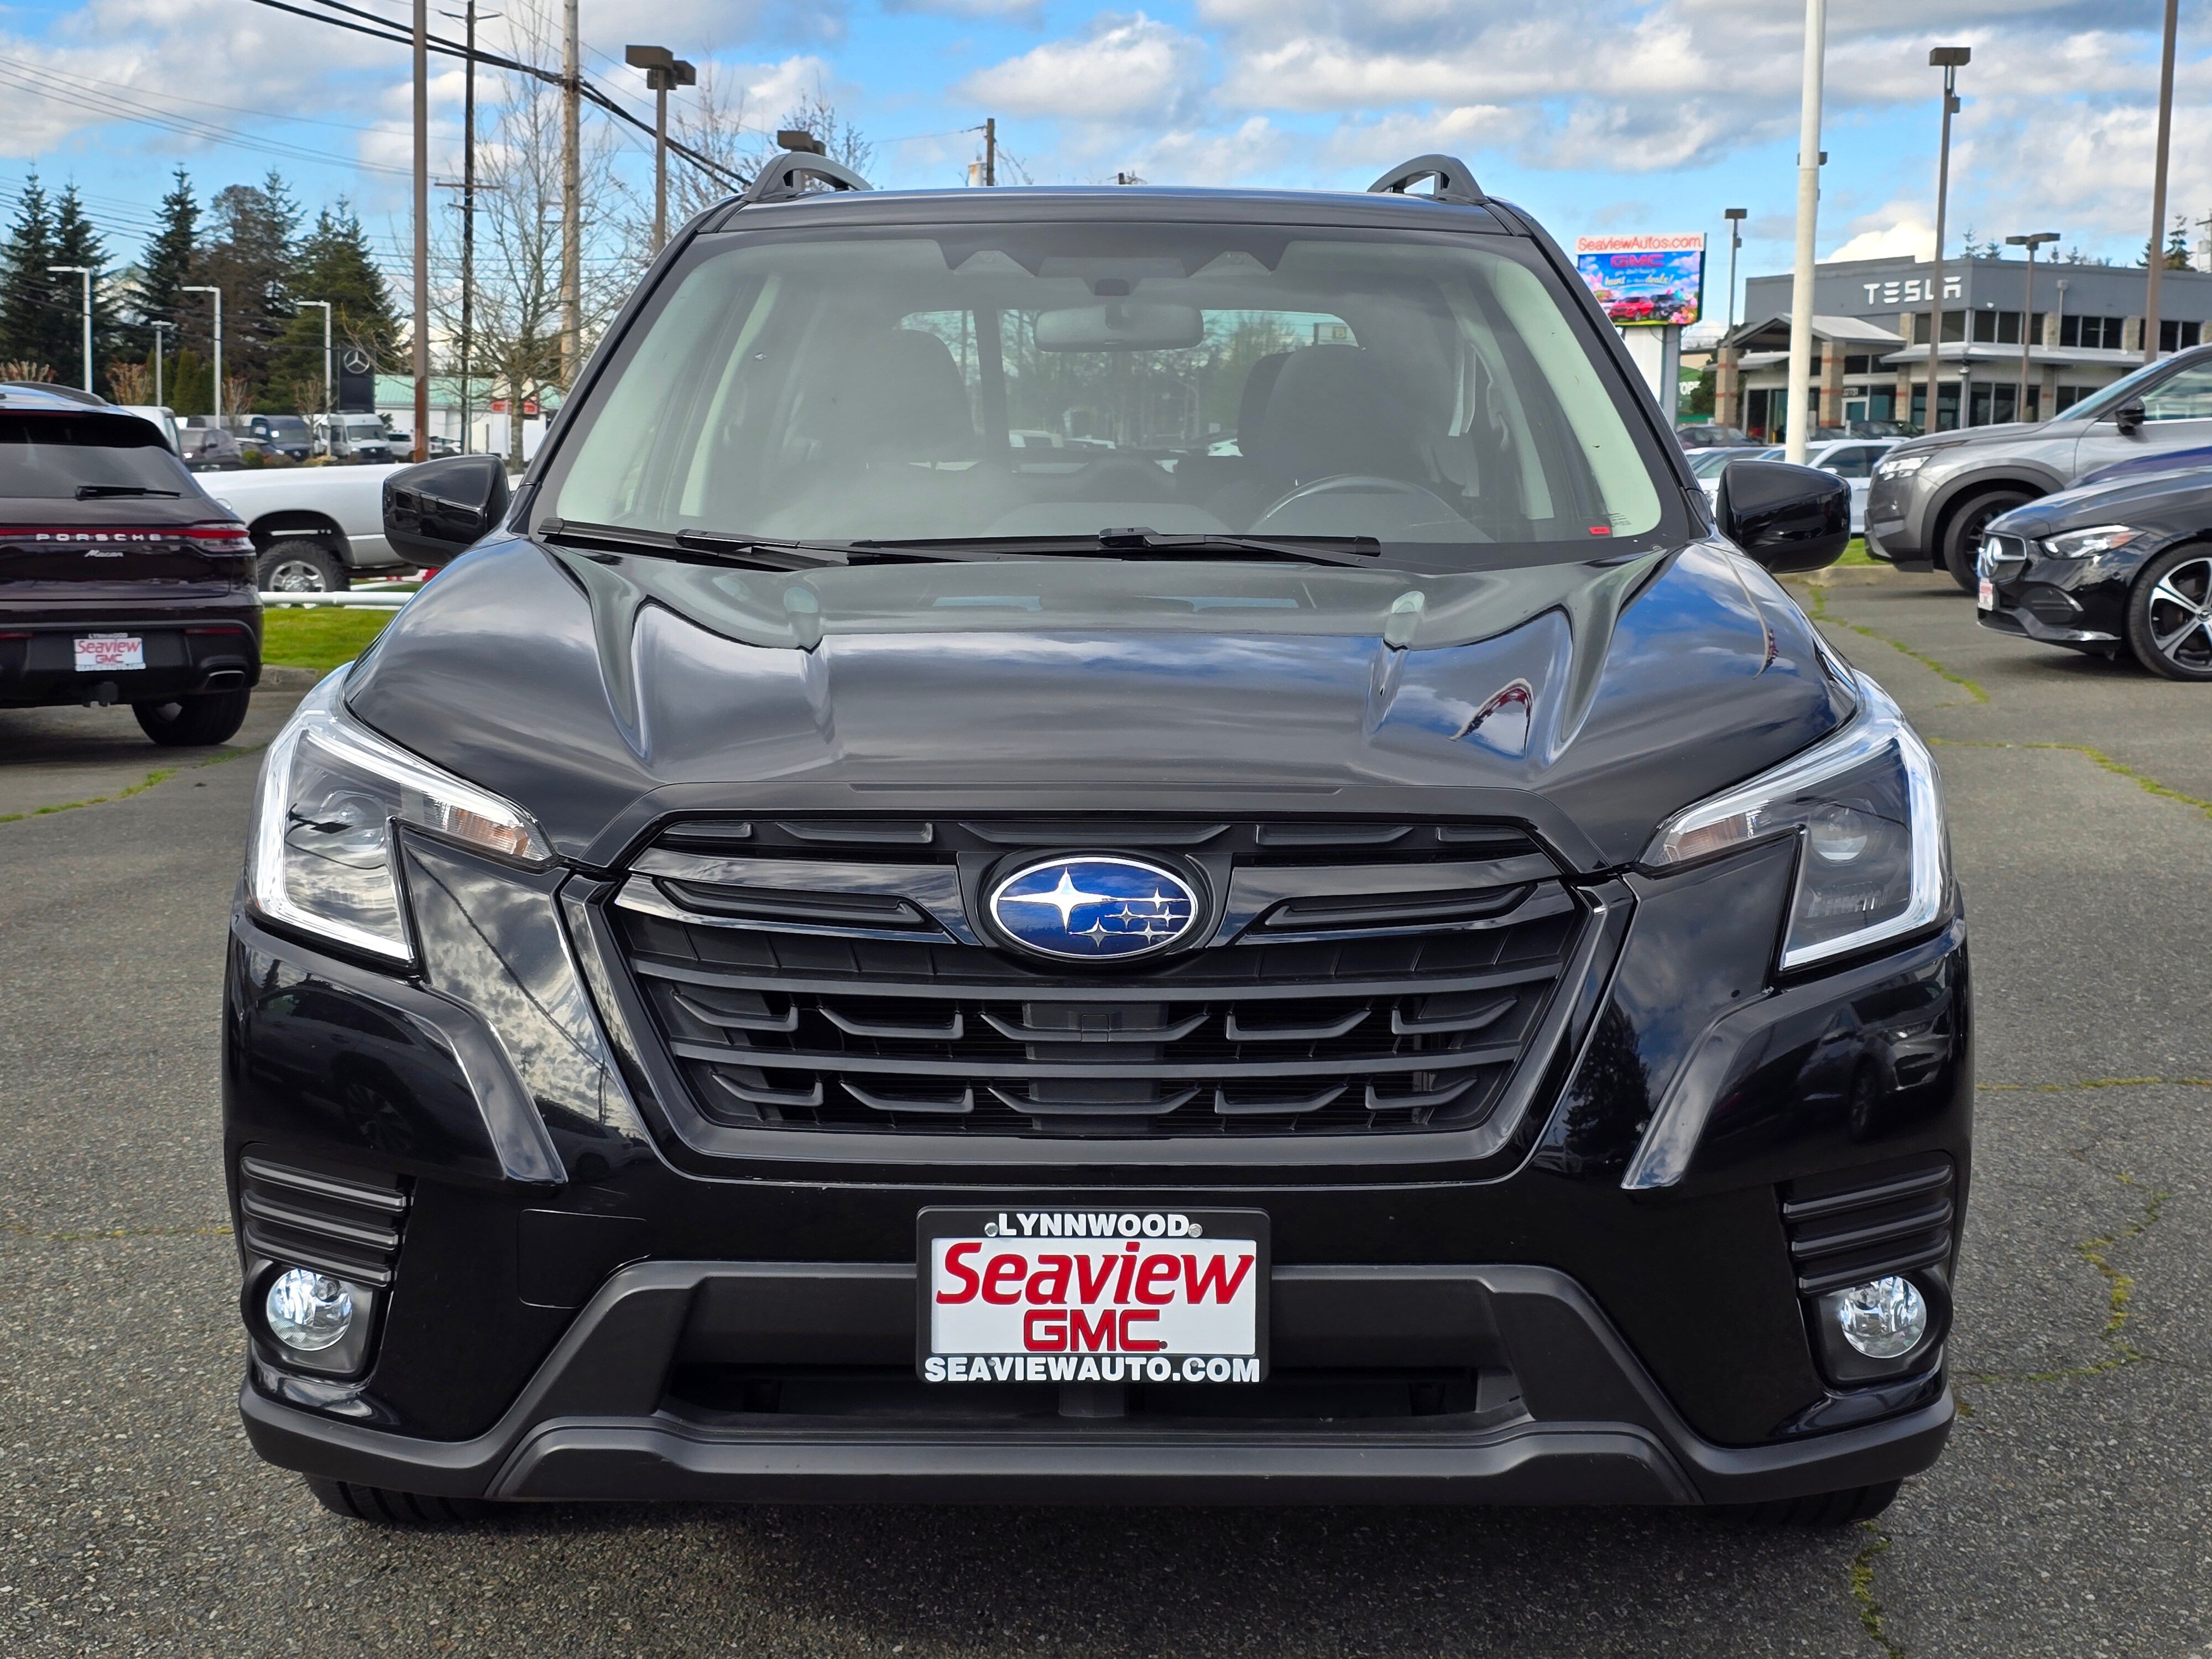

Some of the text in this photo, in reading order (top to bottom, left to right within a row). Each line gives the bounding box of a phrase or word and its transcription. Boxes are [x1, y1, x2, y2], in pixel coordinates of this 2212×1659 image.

[1578, 237, 1703, 251] SeaviewAutos.com
[1610, 254, 1666, 268] GMC
[1863, 276, 1961, 305] TESLA
[76, 639, 141, 654] Seaview
[96, 654, 124, 664] GMC
[998, 1213, 1190, 1237] LYNNWOOD
[936, 1241, 1255, 1305] Seaview
[925, 1357, 1260, 1383] SEAVIEWAUTO.COM
